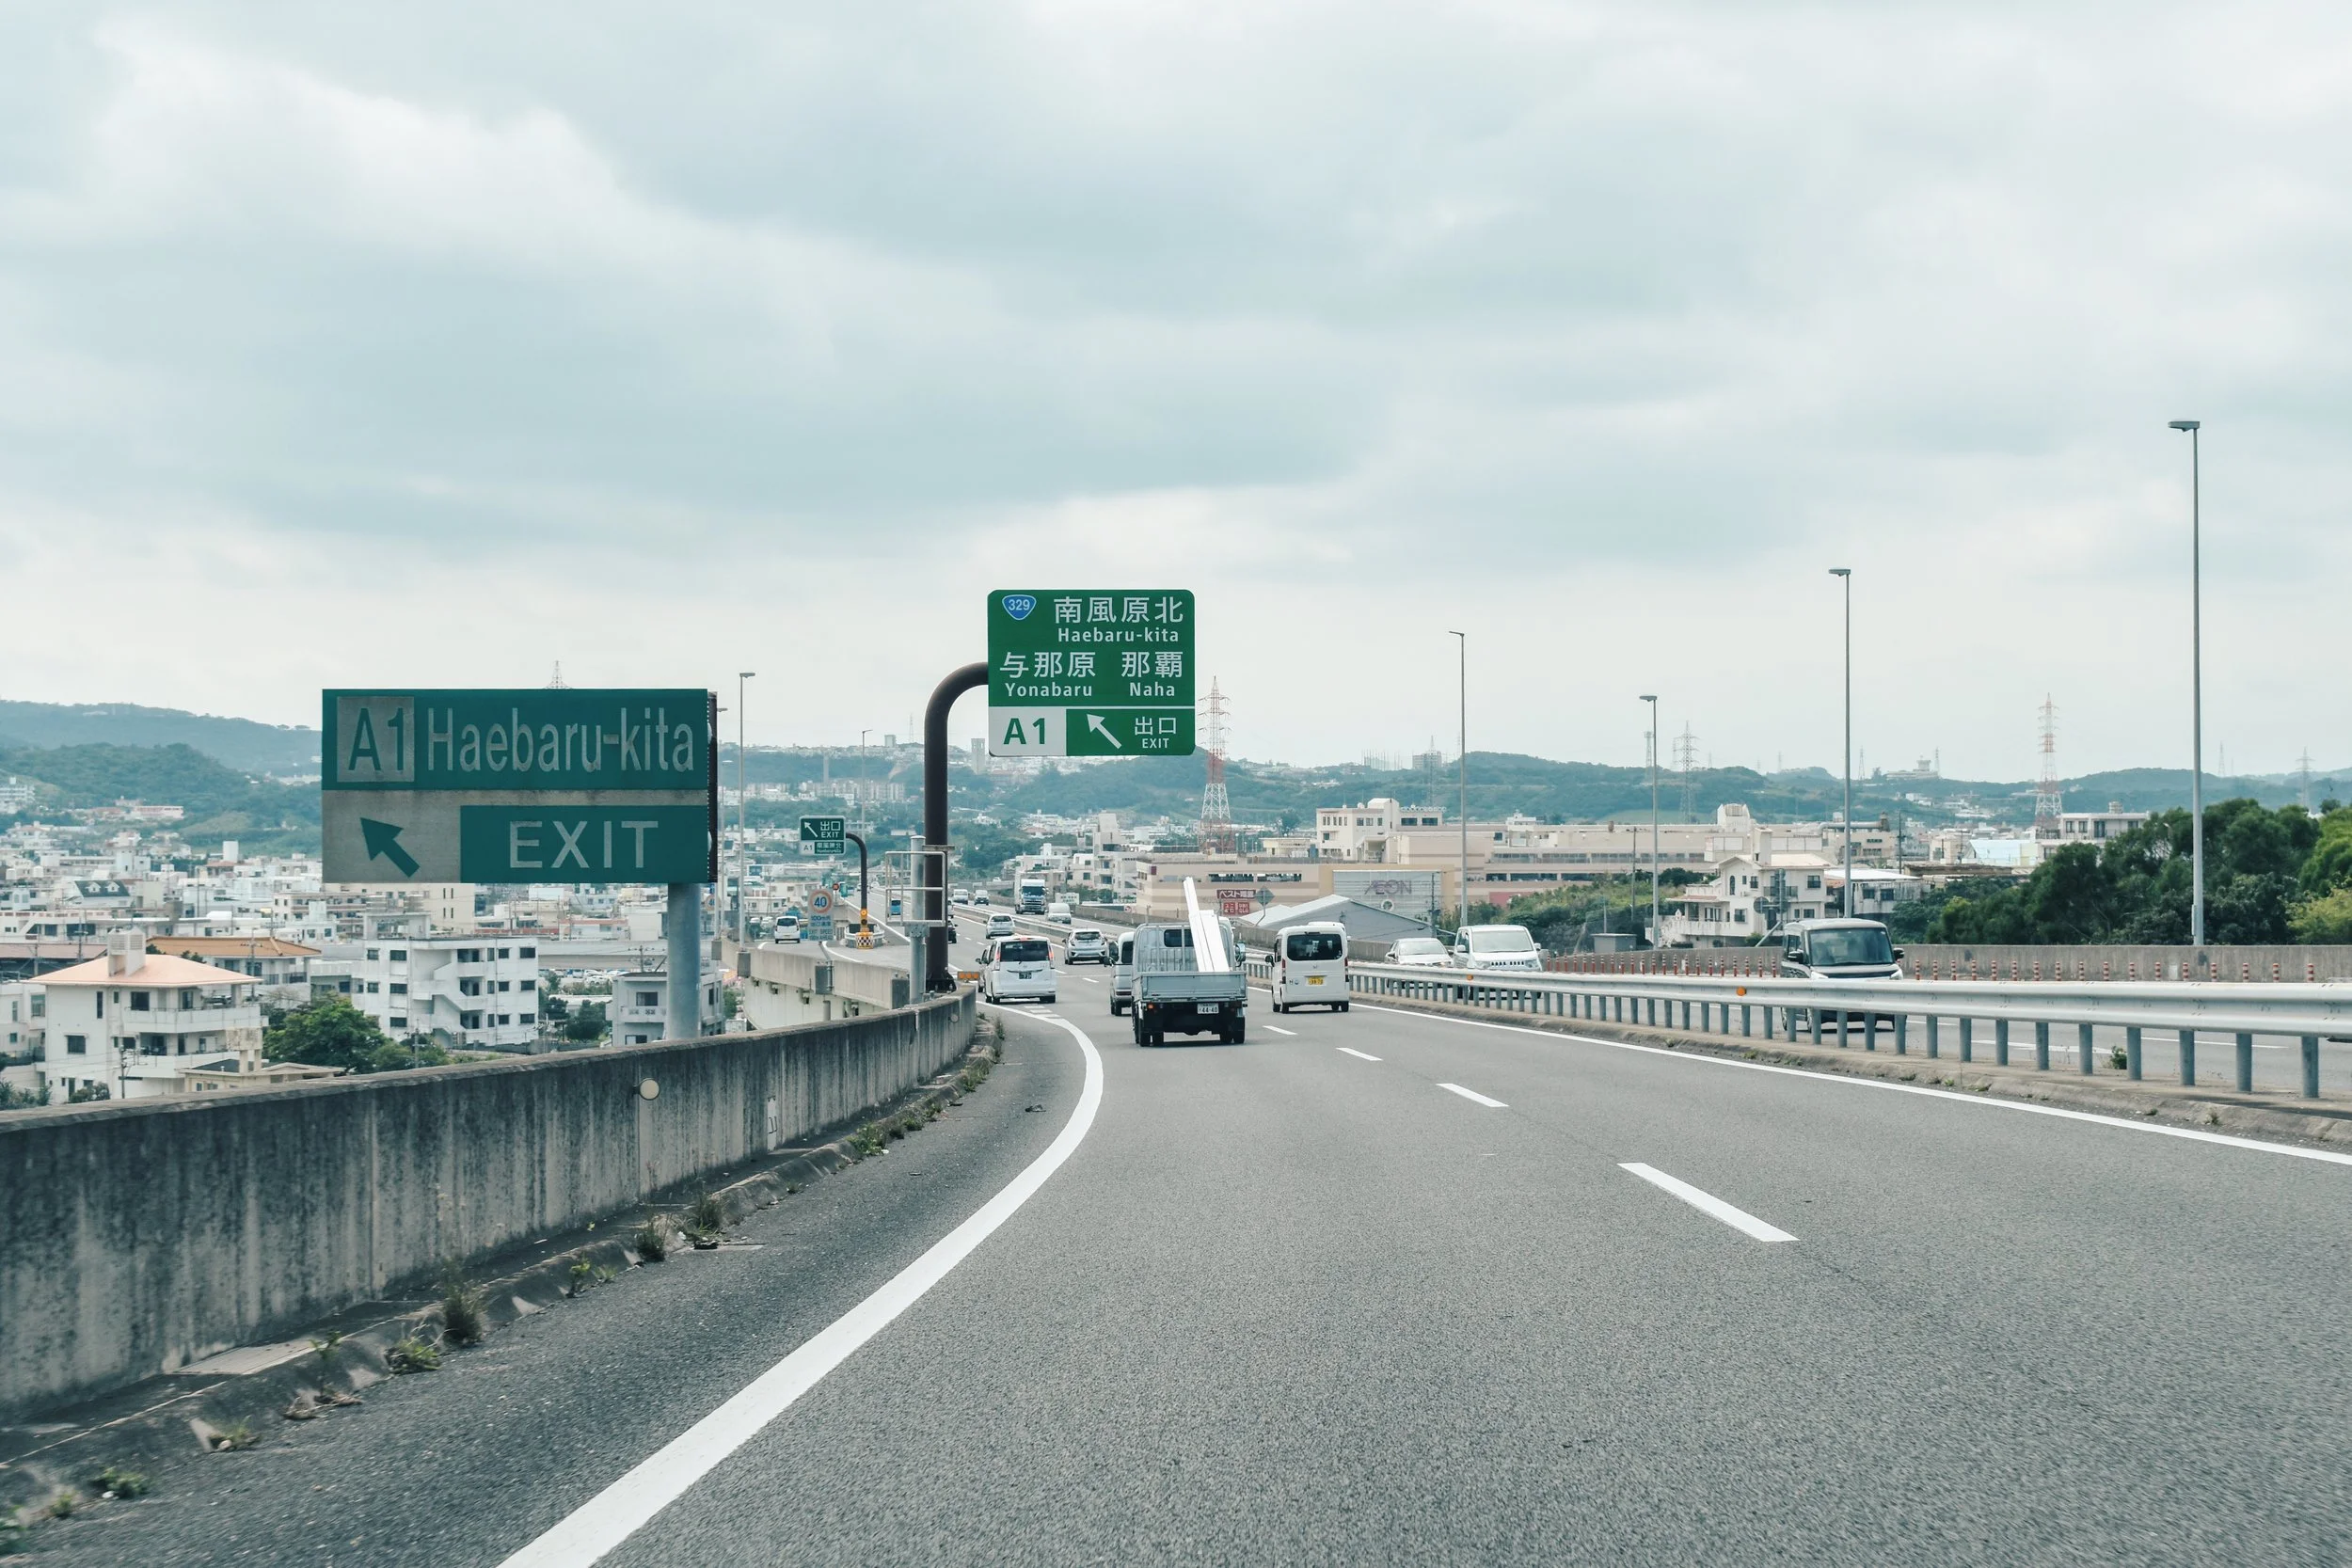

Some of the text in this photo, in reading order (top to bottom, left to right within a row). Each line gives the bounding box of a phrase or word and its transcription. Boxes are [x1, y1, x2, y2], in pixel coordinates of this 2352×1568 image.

[1008, 599, 1030, 611] 329
[1053, 595, 1184, 624] 南風原北
[1057, 627, 1179, 642] Haebaru-kita
[1000, 651, 1183, 678] 与那原 那覇
[1005, 683, 1175, 697] Yonabaru Naha
[1003, 718, 1046, 745] A1
[1134, 717, 1177, 736] 出口
[349, 707, 694, 772] A1 Haebaru-kita
[1142, 738, 1169, 749] EXIT
[820, 821, 841, 831] 出口
[509, 820, 659, 869] EXIT
[814, 896, 827, 908] 40
